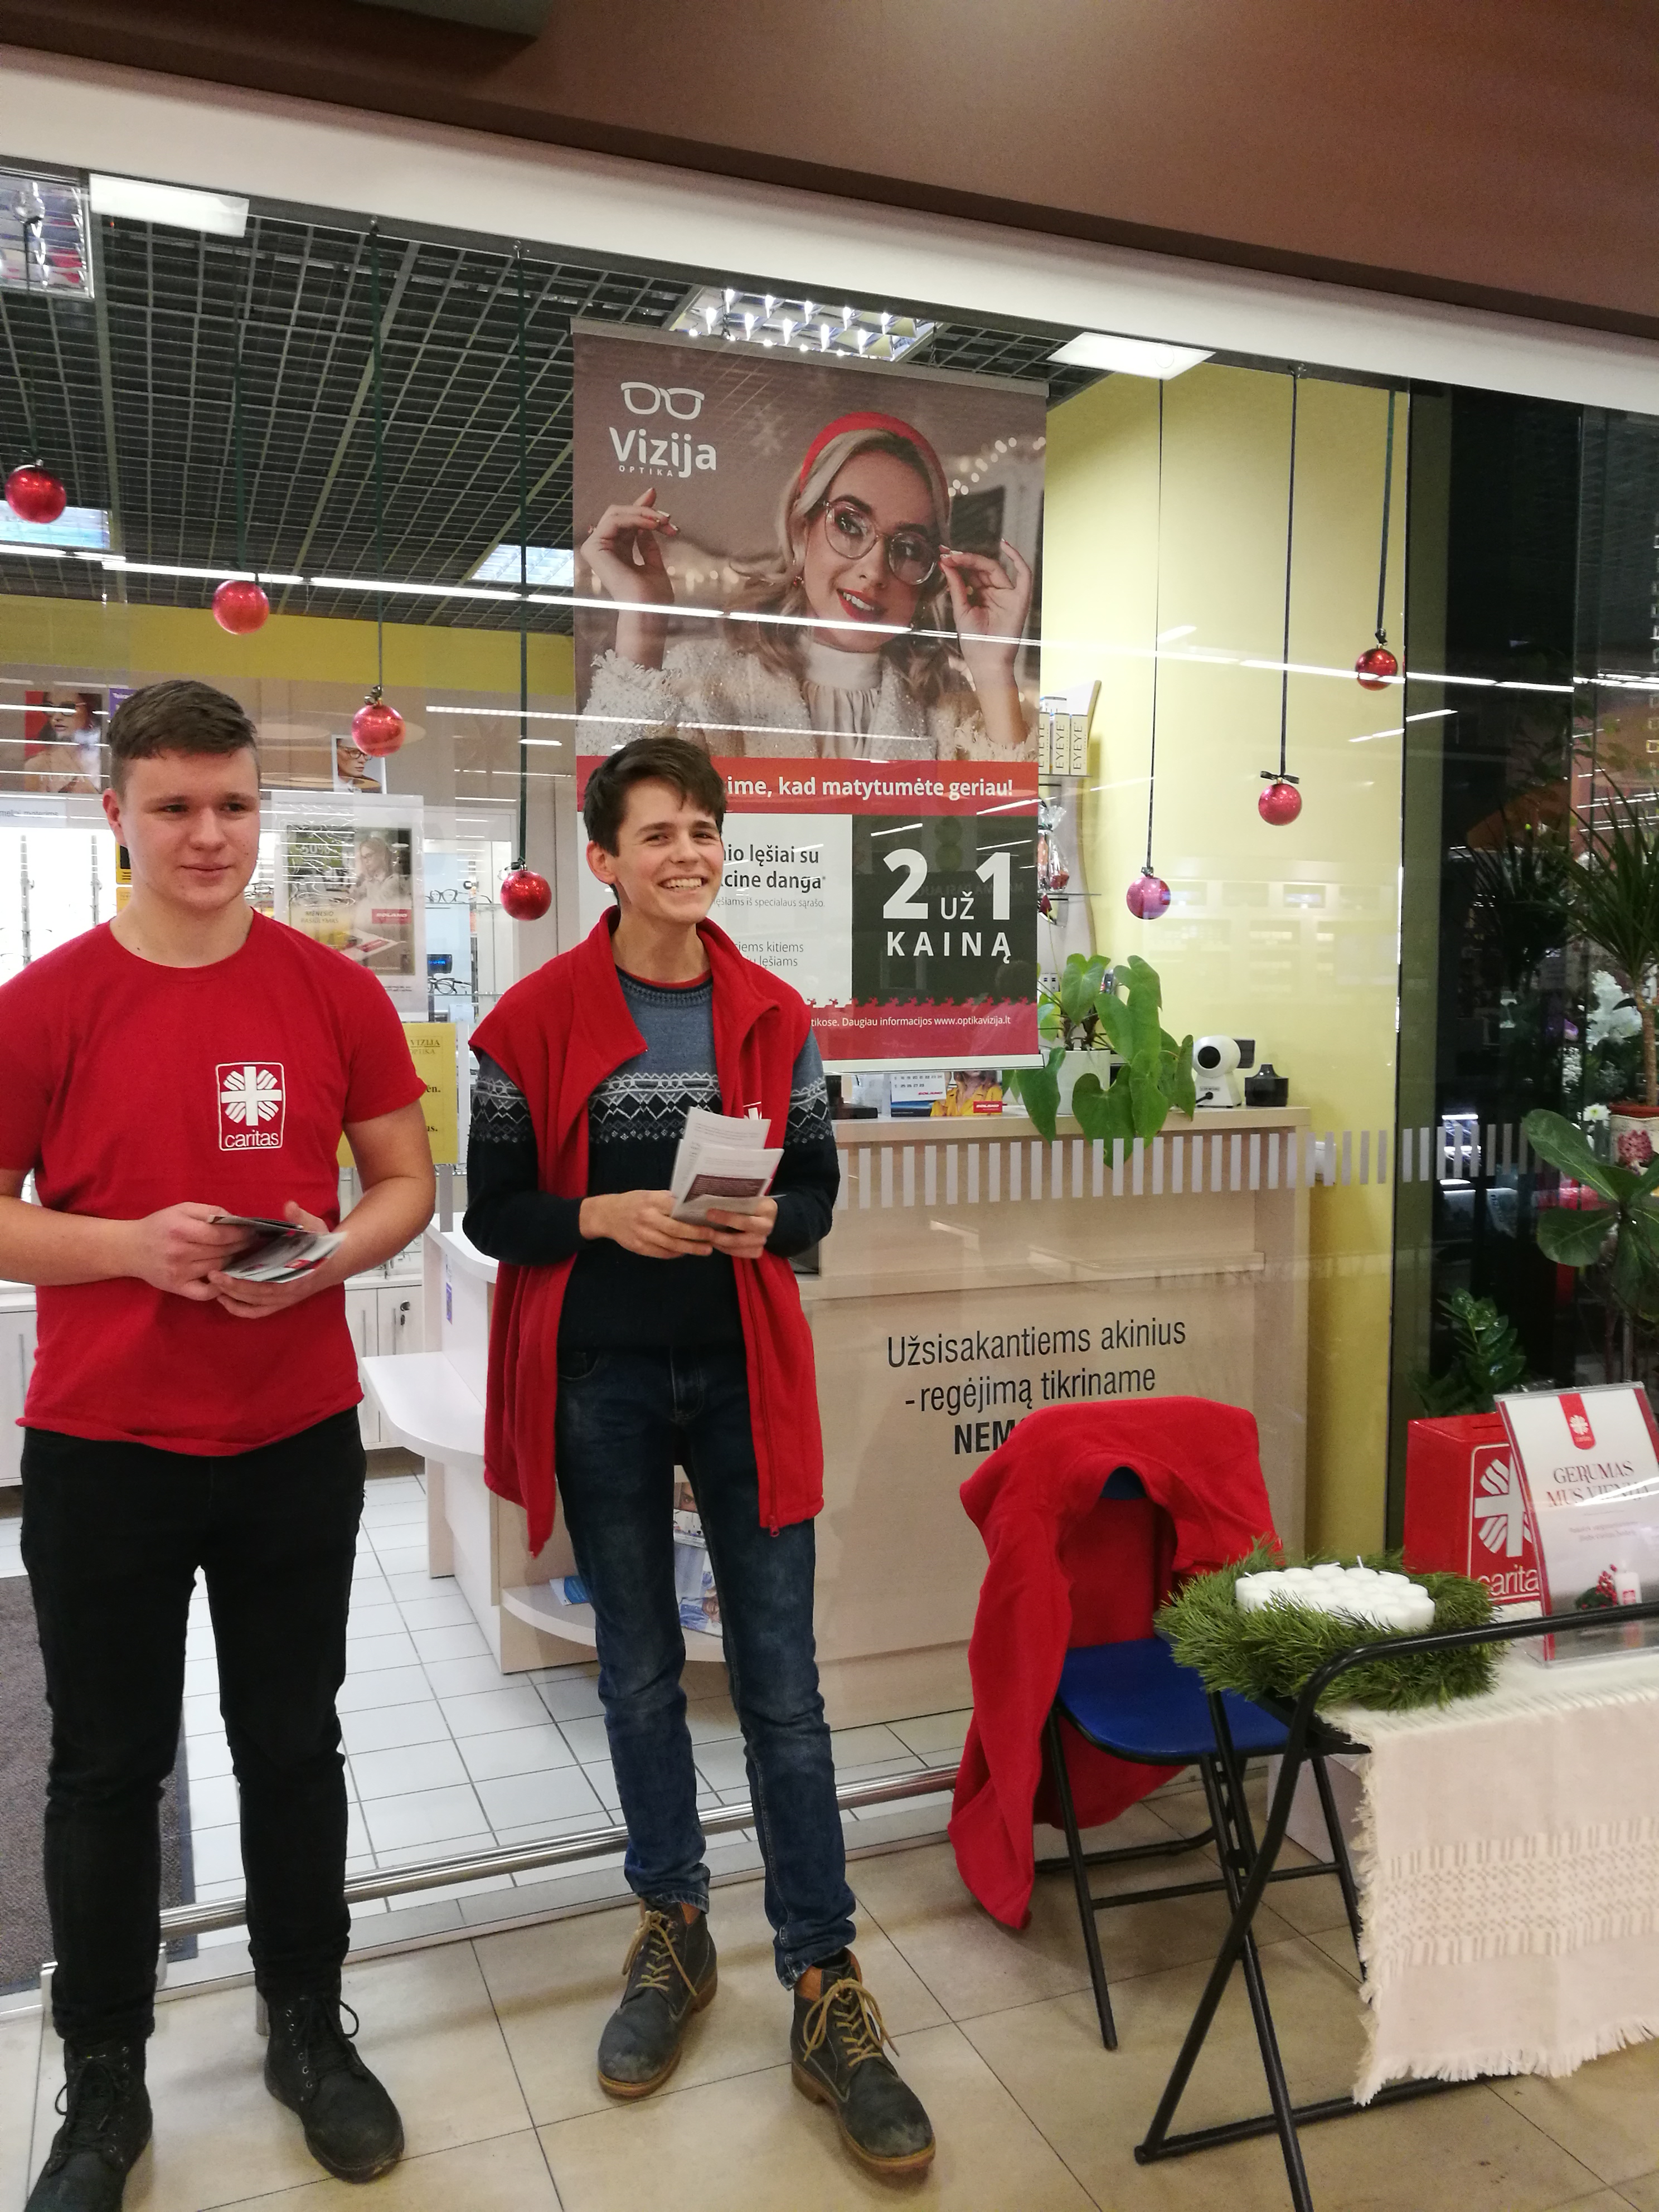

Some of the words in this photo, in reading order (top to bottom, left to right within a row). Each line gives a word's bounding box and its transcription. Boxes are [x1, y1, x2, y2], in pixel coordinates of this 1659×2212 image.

[609, 427, 716, 478] Vizija
[619, 465, 673, 477] OPTIKA
[726, 776, 773, 798] ime,
[779, 776, 816, 795] kad
[822, 778, 944, 801] matytumėte
[949, 778, 1012, 801] geriau!
[750, 844, 795, 866] lęšiai
[800, 851, 819, 864] su
[883, 848, 928, 919] 2
[940, 891, 974, 920] UŽ
[976, 852, 1011, 920] 1
[746, 898, 753, 906] iš
[755, 898, 797, 908] specialaus
[798, 899, 825, 909] sąrašo.
[767, 941, 804, 952] kitiems
[887, 932, 1011, 964] KAINĄ
[760, 955, 798, 968] lęšiams
[811, 1018, 840, 1027] tikose.
[842, 1017, 877, 1029] Daugiau
[880, 1017, 932, 1027] informacijos
[934, 1016, 1011, 1027] www.optikavizija.lt
[225, 1129, 279, 1148] caritas
[887, 1326, 1091, 1368] Užsisakantiems
[1101, 1317, 1186, 1350] akinius
[1040, 1367, 1156, 1400] tikriname
[954, 1419, 1023, 1455] NEM
[1553, 1461, 1634, 1485] GERUMAS
